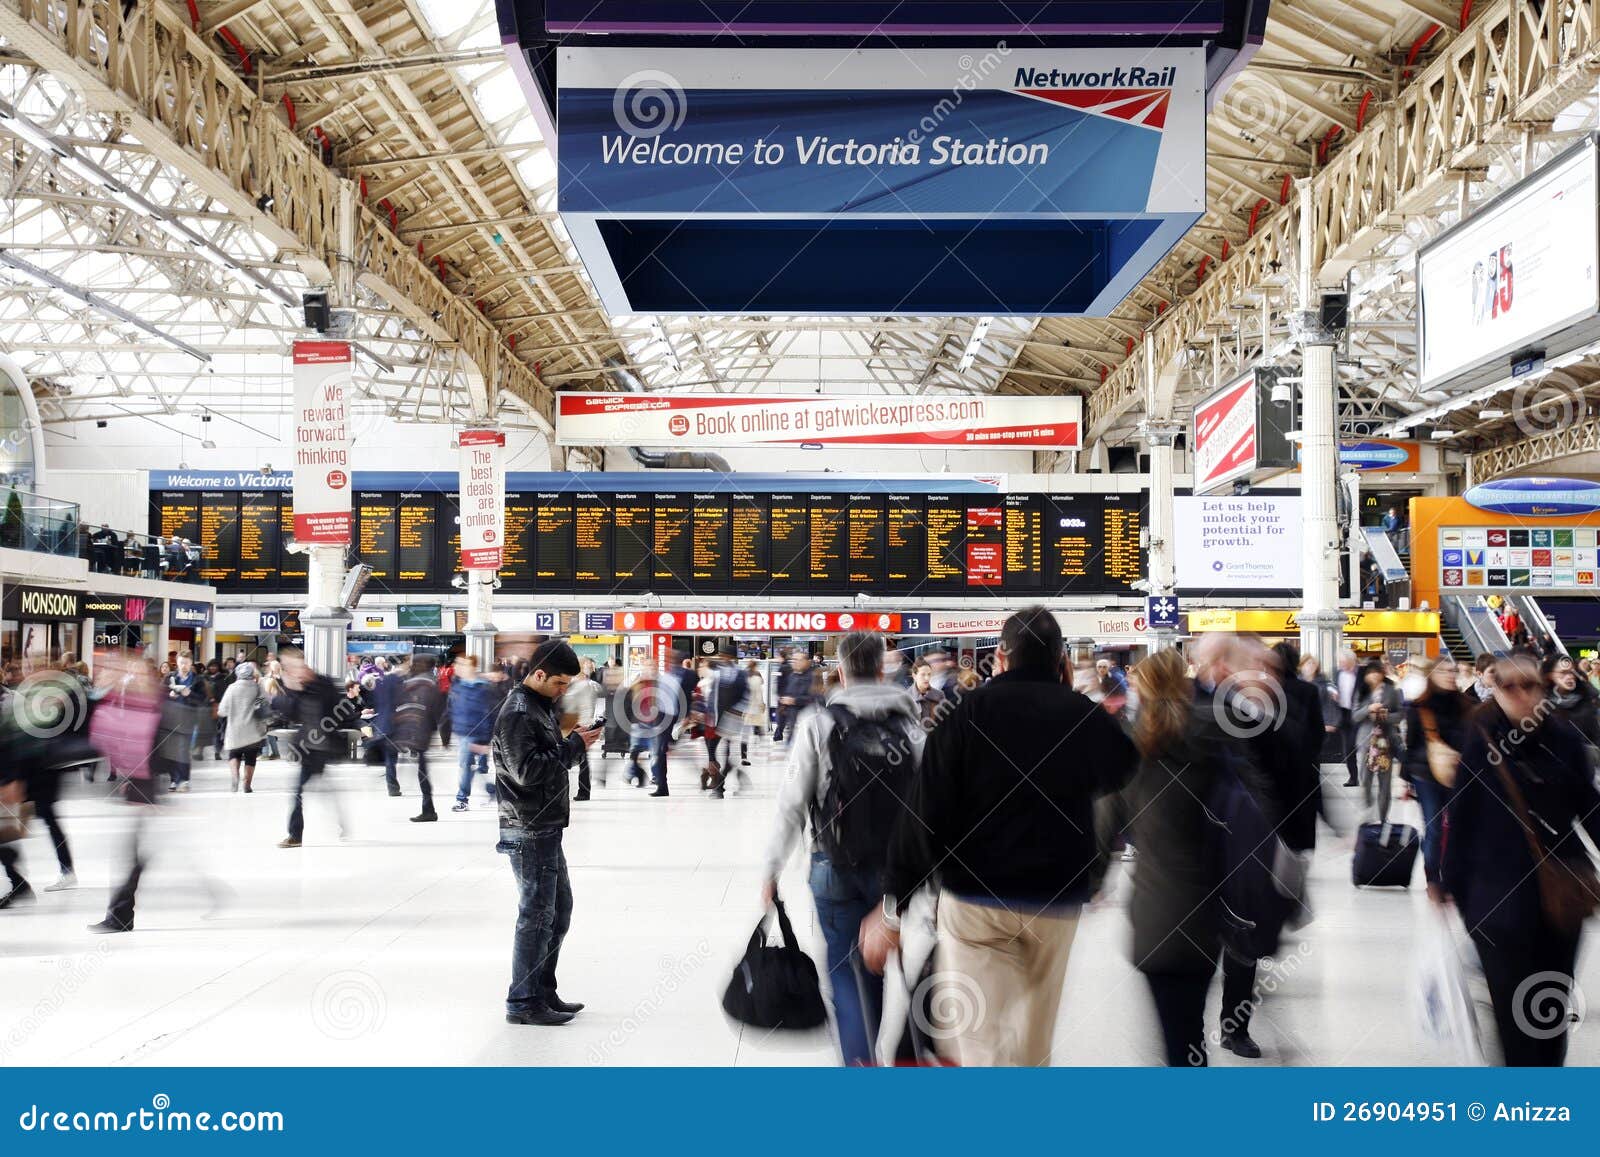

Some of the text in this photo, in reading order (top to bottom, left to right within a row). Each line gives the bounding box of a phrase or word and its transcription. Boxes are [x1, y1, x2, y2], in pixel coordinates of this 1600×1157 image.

[1014, 66, 1176, 88] NetworkRail
[600, 134, 1049, 165] Welcome to Victoria Station
[324, 384, 342, 401] We
[303, 404, 344, 422] reward
[696, 400, 984, 435] Book online at gatwickexpress.com
[297, 424, 346, 442] forward
[297, 448, 346, 465] thinking
[472, 450, 491, 464] The
[168, 473, 293, 487] Welcome to Victoria
[471, 466, 492, 480] best
[467, 482, 493, 496] deals
[478, 497, 494, 510] are
[1203, 502, 1224, 511] Let
[1248, 502, 1275, 513] help
[466, 512, 496, 527] online
[1203, 514, 1280, 525] unlock your
[1203, 525, 1285, 536] potential for
[1203, 537, 1254, 548] growth.
[22, 592, 76, 616] MONSOON
[262, 615, 276, 626] 10
[538, 615, 552, 627] 12
[686, 614, 826, 630] BURGER KING
[907, 619, 919, 629] 13
[1098, 620, 1130, 632] Tickets
